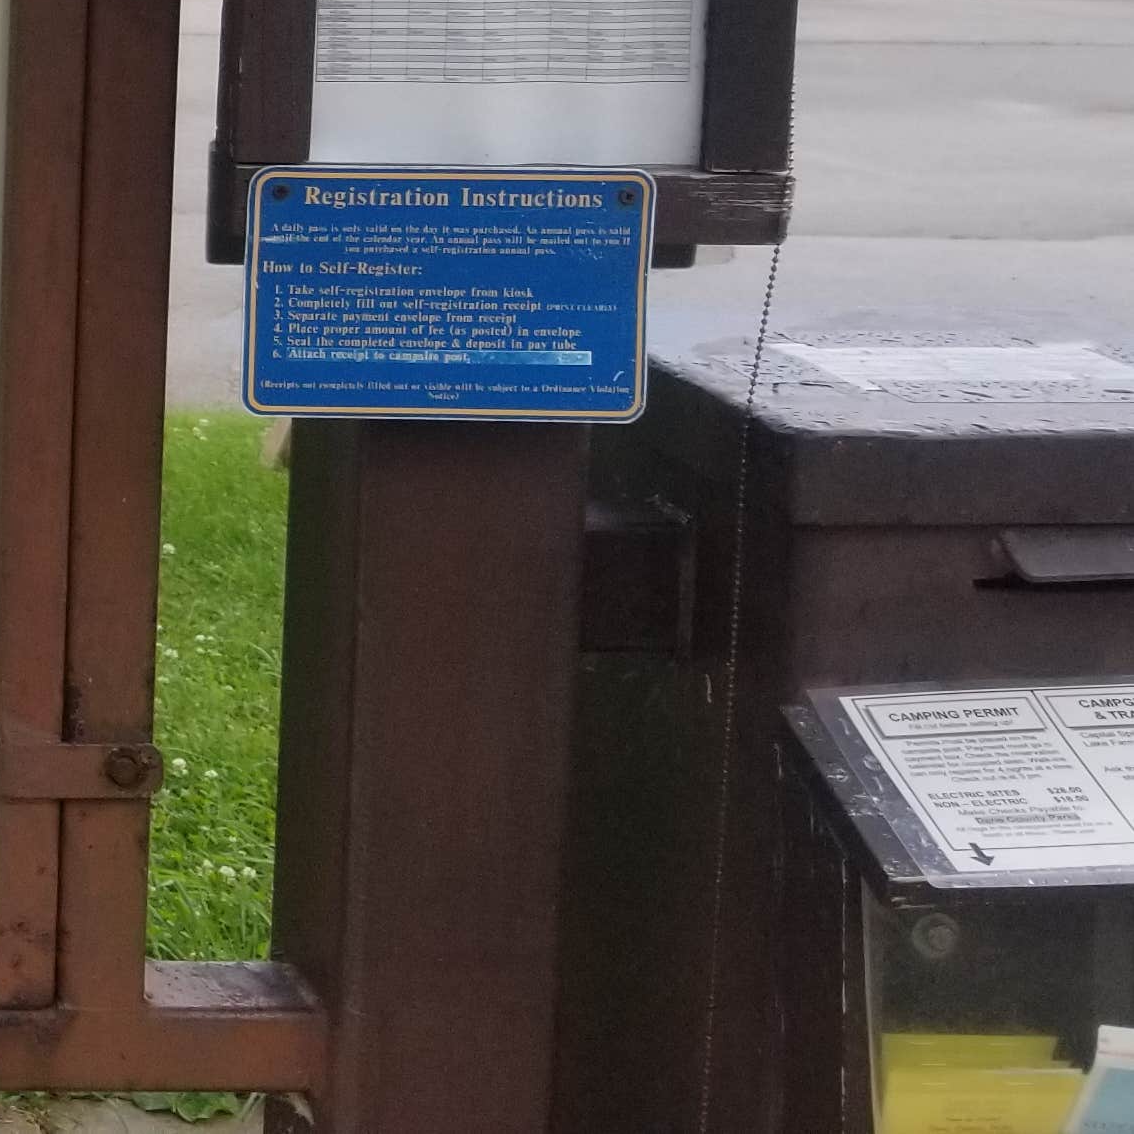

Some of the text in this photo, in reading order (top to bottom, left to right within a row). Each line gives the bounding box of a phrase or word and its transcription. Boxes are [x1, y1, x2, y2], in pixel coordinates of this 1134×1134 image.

[304, 186, 604, 209] Registration Instructions
[263, 260, 423, 277] How to Self-Register:
[287, 285, 314, 295] Take
[318, 286, 414, 297] self-registration
[419, 287, 466, 298] envelope
[471, 287, 498, 297] from
[503, 287, 534, 298] kiosk
[287, 311, 337, 322] Separate
[342, 313, 389, 323] payment
[394, 312, 441, 323] envelope
[447, 313, 473, 323] from
[478, 314, 517, 324] receipt
[288, 323, 318, 334] Place
[323, 326, 360, 336] proper
[365, 324, 407, 335] amount
[411, 325, 423, 335] of
[428, 325, 444, 335] fee
[450, 325, 467, 336] (as
[471, 326, 513, 337] posted)
[518, 327, 529, 336] in
[533, 326, 583, 338] envelope
[1079, 698, 1134, 708] CAMPG
[889, 707, 1019, 722] CAMPING PERMIT
